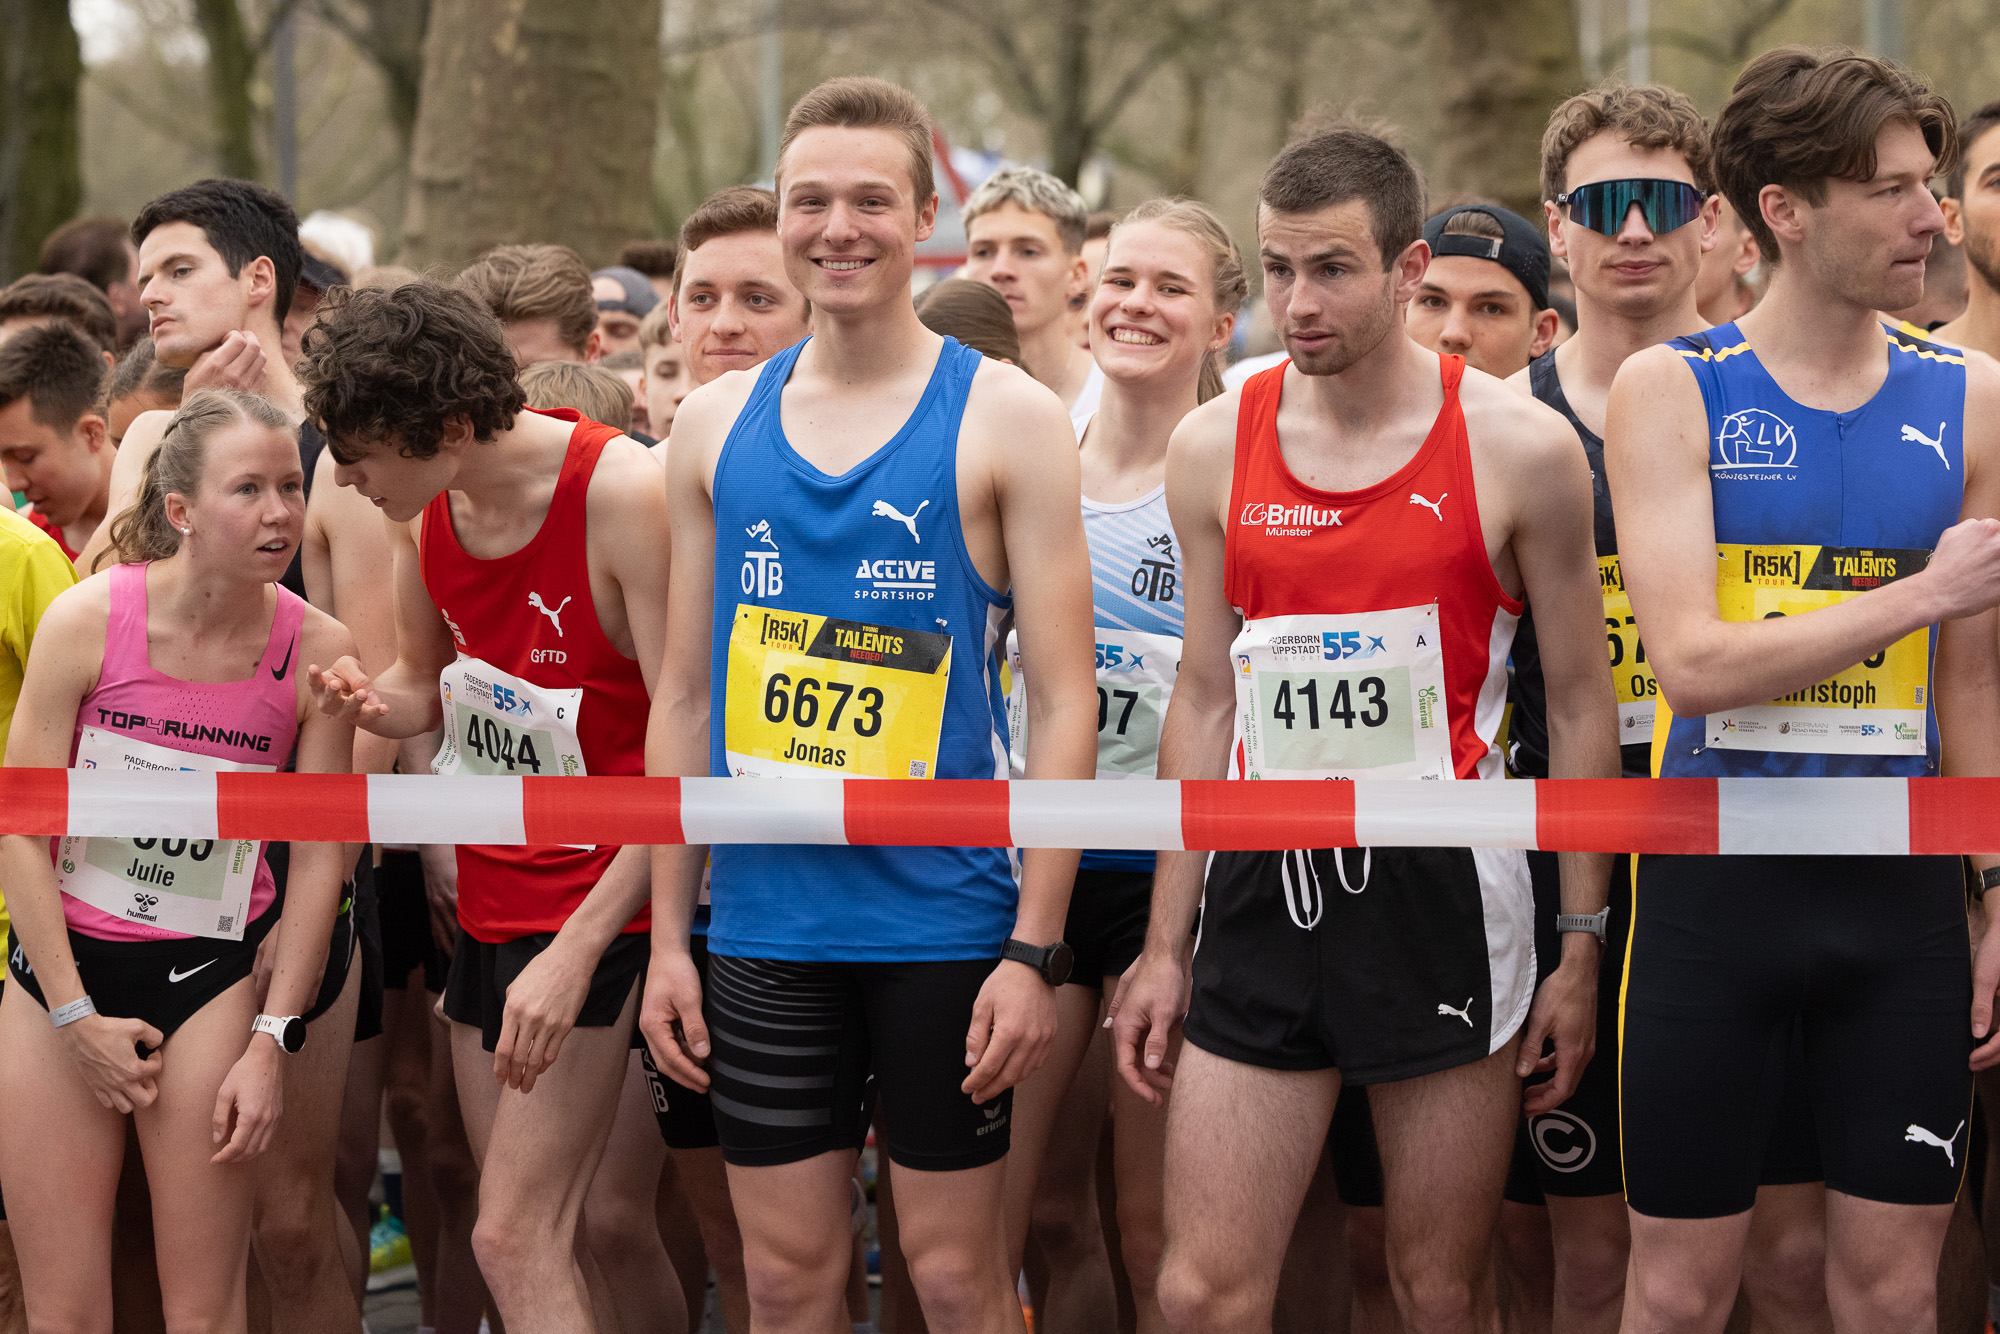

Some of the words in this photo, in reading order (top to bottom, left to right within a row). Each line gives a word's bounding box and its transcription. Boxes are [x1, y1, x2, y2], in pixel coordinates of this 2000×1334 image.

[1714, 470, 1783, 481] KÖNIGSTEINER
[1266, 503, 1344, 526] Brillux
[1265, 527, 1313, 537] Münster
[741, 550, 783, 598] OTB
[1833, 556, 1897, 577] TALENTS
[1131, 558, 1176, 602] OTB
[1758, 578, 1785, 586] TOUR
[854, 590, 935, 601] SPORTSHOP
[862, 625, 879, 633] YOUNG
[771, 641, 793, 651] TOUR
[835, 628, 904, 655] TALENTS
[1271, 645, 1321, 655] LIPPSTADT
[1322, 631, 1362, 661] 55
[1415, 634, 1427, 648] A
[1606, 616, 1646, 668] 67
[530, 648, 567, 664] GfTD
[850, 649, 884, 662] NEEDED!
[493, 682, 518, 712] 55
[1631, 674, 1657, 698] Os
[556, 707, 565, 720] C
[763, 672, 885, 738] 6673
[1273, 676, 1389, 731] 4143
[97, 707, 272, 752] TOP4RUNNING
[1861, 724, 1876, 736] 55
[467, 713, 542, 775] 4044
[783, 736, 847, 767] Jonas
[126, 857, 175, 887] Julie
[126, 908, 158, 922] hummel
